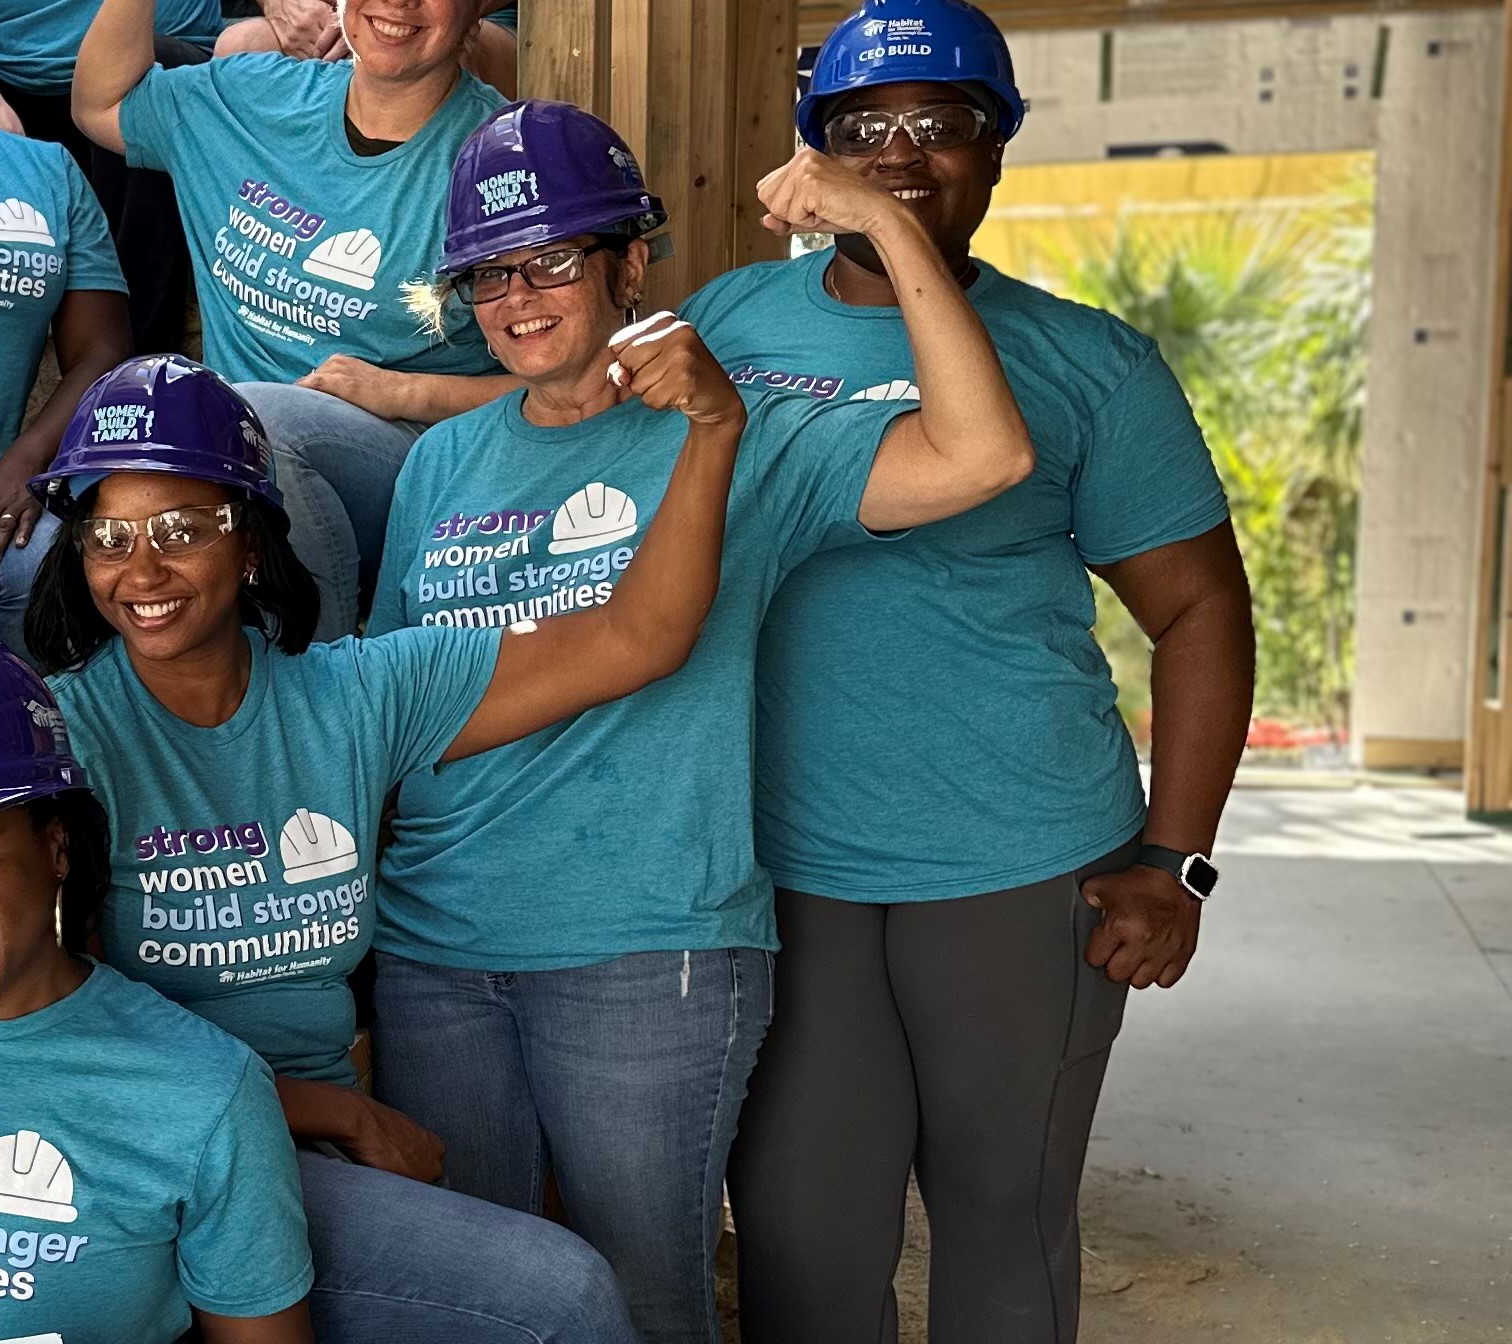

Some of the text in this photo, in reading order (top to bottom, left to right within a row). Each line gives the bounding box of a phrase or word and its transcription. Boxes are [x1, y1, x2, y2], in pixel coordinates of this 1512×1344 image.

[888, 19, 924, 29] Habitat
[859, 45, 932, 62] CEO BUILD
[476, 169, 527, 194] WOMEN
[484, 182, 521, 204] BUILD
[238, 177, 326, 242] strong
[481, 192, 528, 216] TAMPA
[229, 204, 297, 260] women
[214, 226, 378, 321] build stronger
[212, 258, 342, 337] communities
[282, 325, 316, 346] Humanity
[94, 405, 146, 420] WOMEN
[98, 417, 136, 431] BUILD
[92, 428, 138, 443] TAMPA
[425, 535, 530, 569] women
[418, 546, 639, 604] build stronge
[421, 579, 613, 629] communities
[134, 820, 270, 861] strong
[138, 859, 268, 894] women
[142, 872, 370, 932] build stronger
[138, 915, 360, 967] communities
[237, 966, 273, 982] Habitat
[289, 956, 333, 970] Humanity
